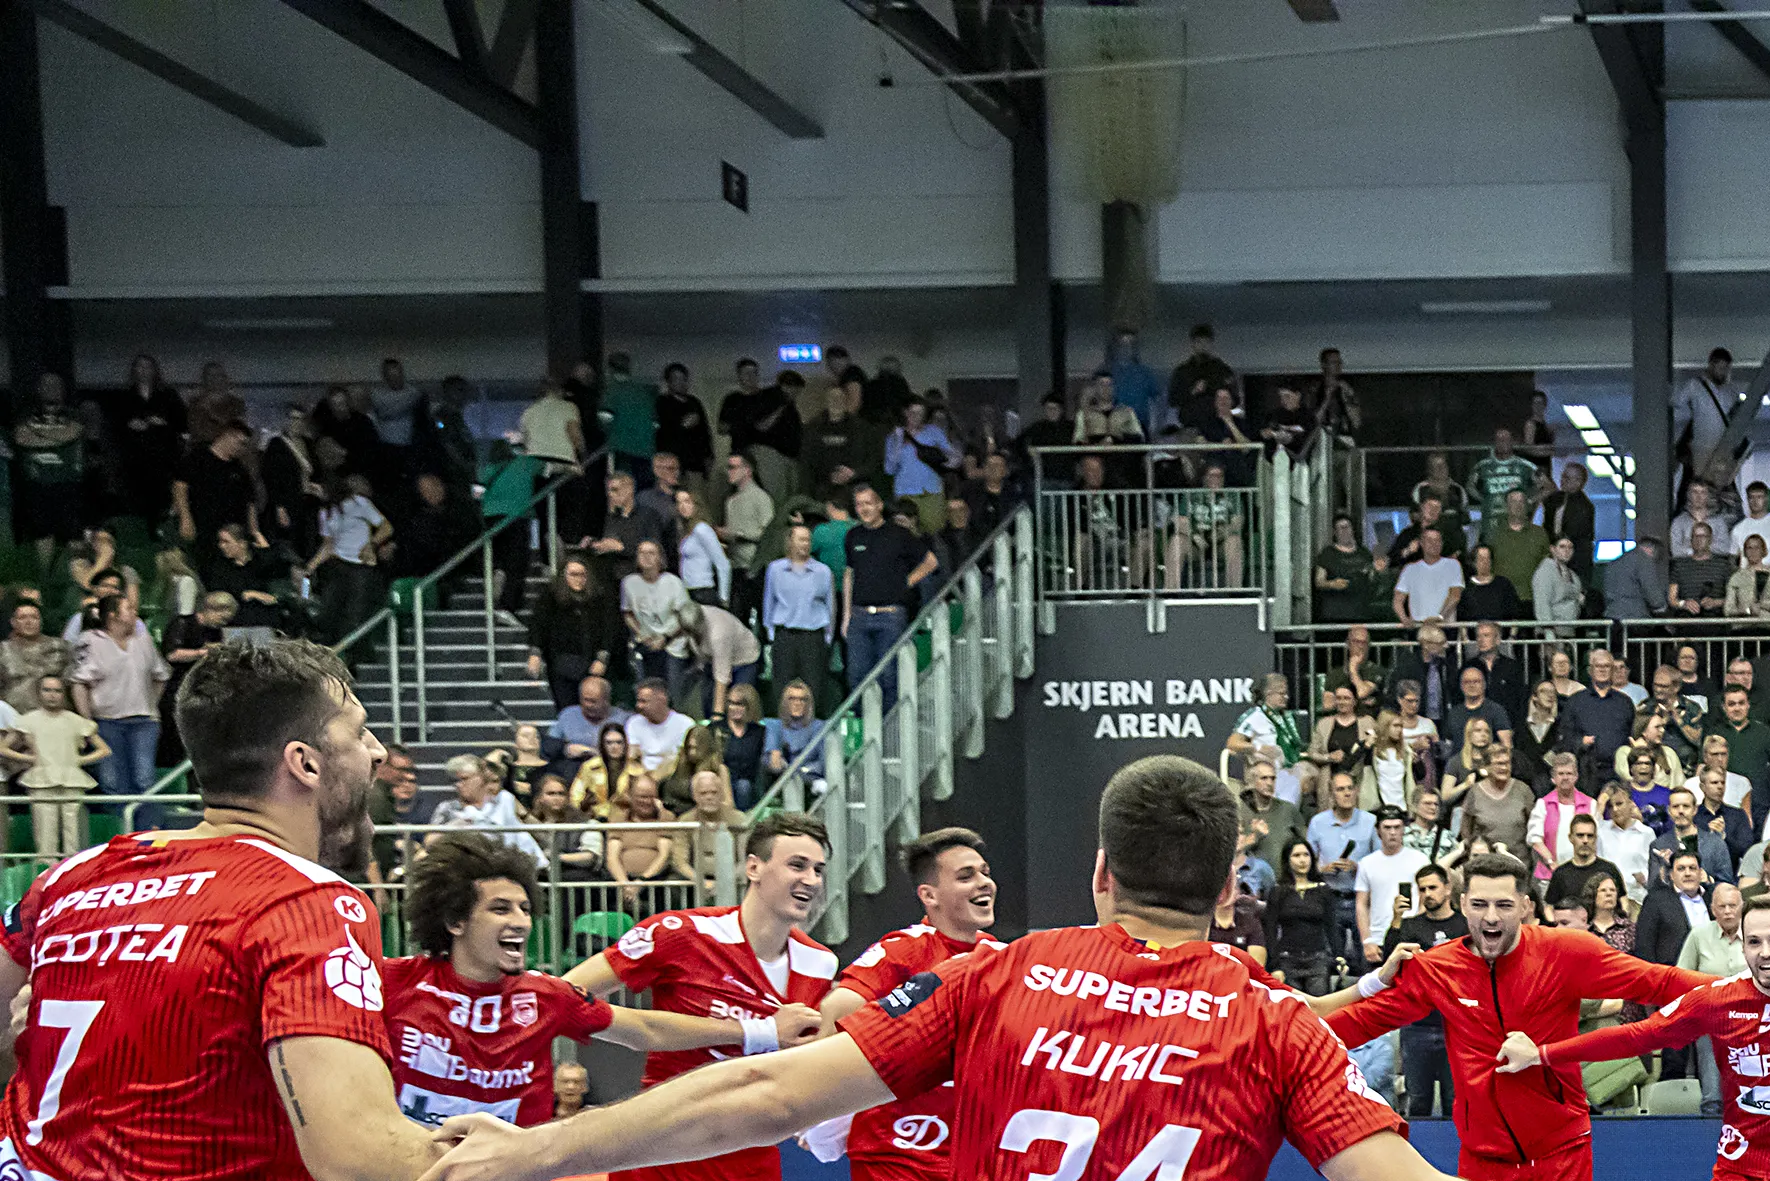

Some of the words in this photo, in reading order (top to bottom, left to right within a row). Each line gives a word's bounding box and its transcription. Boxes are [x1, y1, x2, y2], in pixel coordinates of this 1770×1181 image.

[1043, 680, 1154, 712] SKJERN
[1166, 678, 1254, 705] BANK
[1094, 712, 1205, 739] ARENA
[1024, 964, 1238, 1022] SUPERBET
[1728, 1010, 1759, 1020] Kempa
[27, 1000, 105, 1146] 7
[1020, 1027, 1200, 1085] KUKIC
